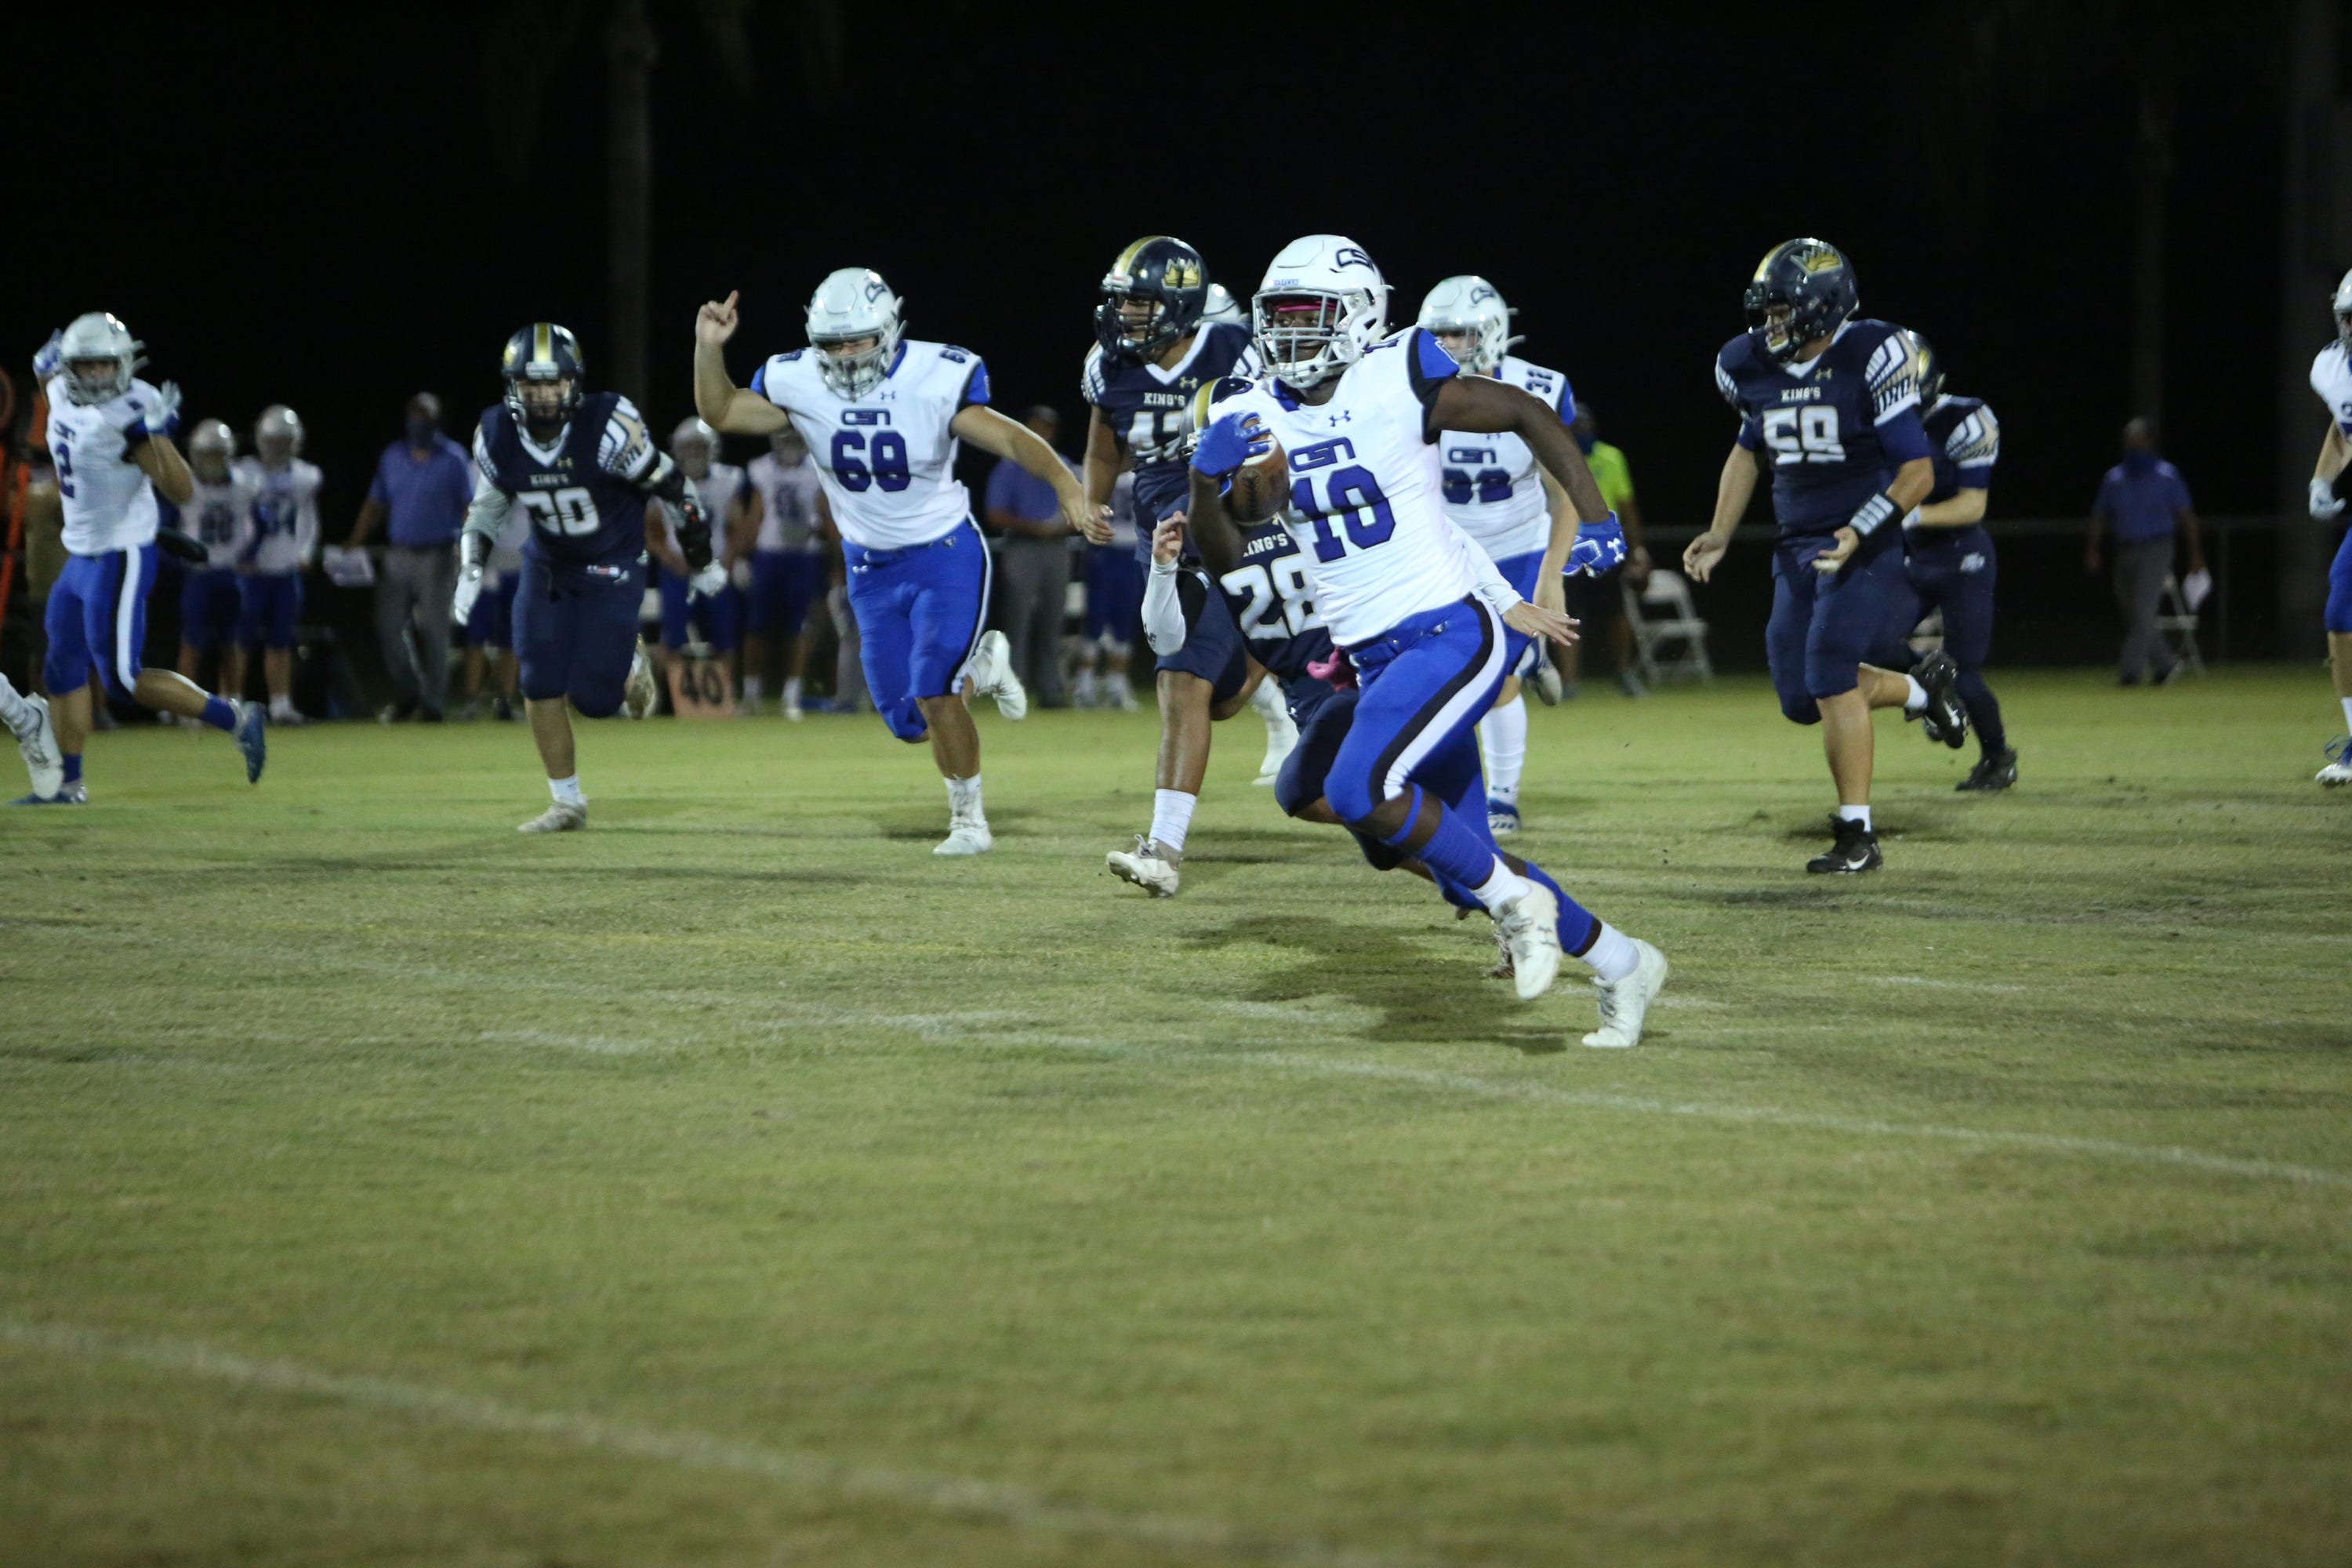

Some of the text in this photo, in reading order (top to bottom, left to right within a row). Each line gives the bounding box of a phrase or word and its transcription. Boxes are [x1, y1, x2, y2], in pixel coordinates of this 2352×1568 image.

[1143, 392, 1186, 407] KING'S
[1780, 387, 1821, 403] KING'S
[55, 442, 76, 499] 2
[1289, 464, 1396, 563] 10
[1243, 532, 1289, 557] ING'S
[1219, 552, 1330, 640] 28
